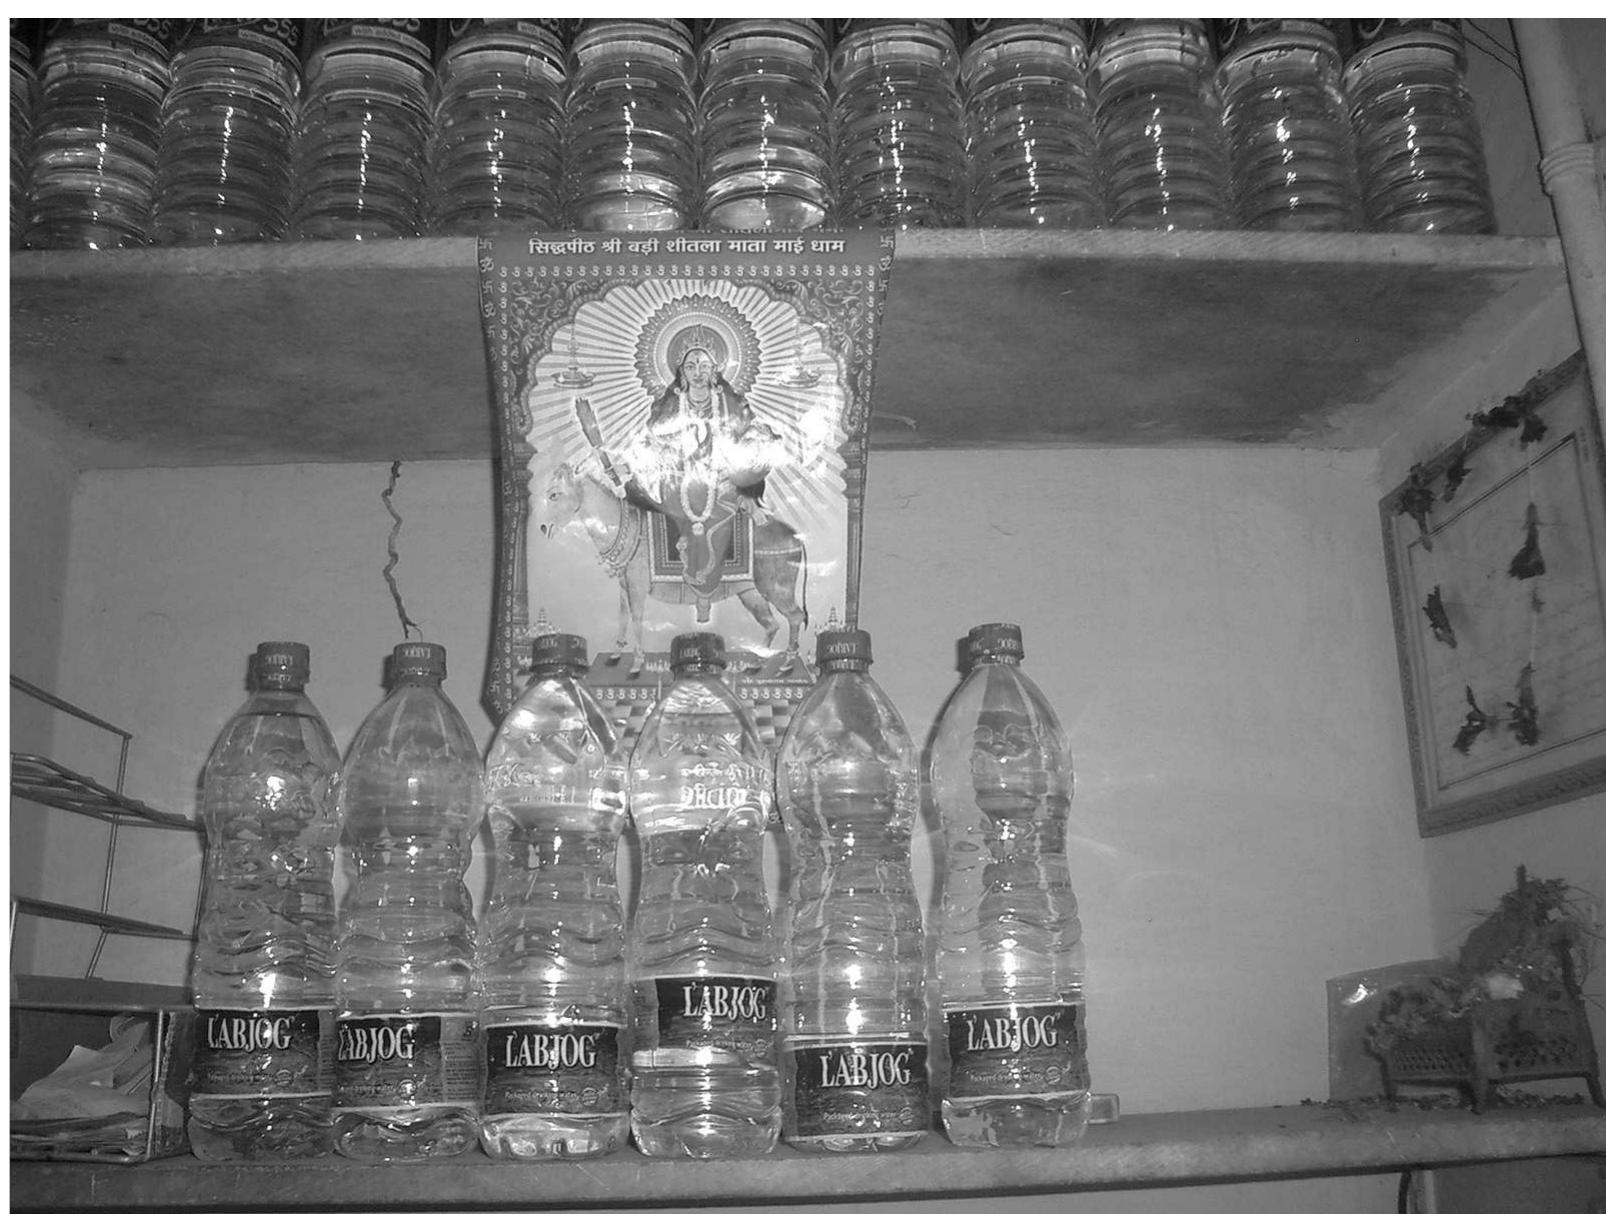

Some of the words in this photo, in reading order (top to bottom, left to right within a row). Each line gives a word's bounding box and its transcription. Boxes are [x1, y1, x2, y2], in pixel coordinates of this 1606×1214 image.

[601, 236, 623, 254] श्री
[665, 236, 722, 253] शीतला
[727, 239, 767, 253] माता
[773, 236, 804, 255] माई
[810, 239, 845, 253] धाम
